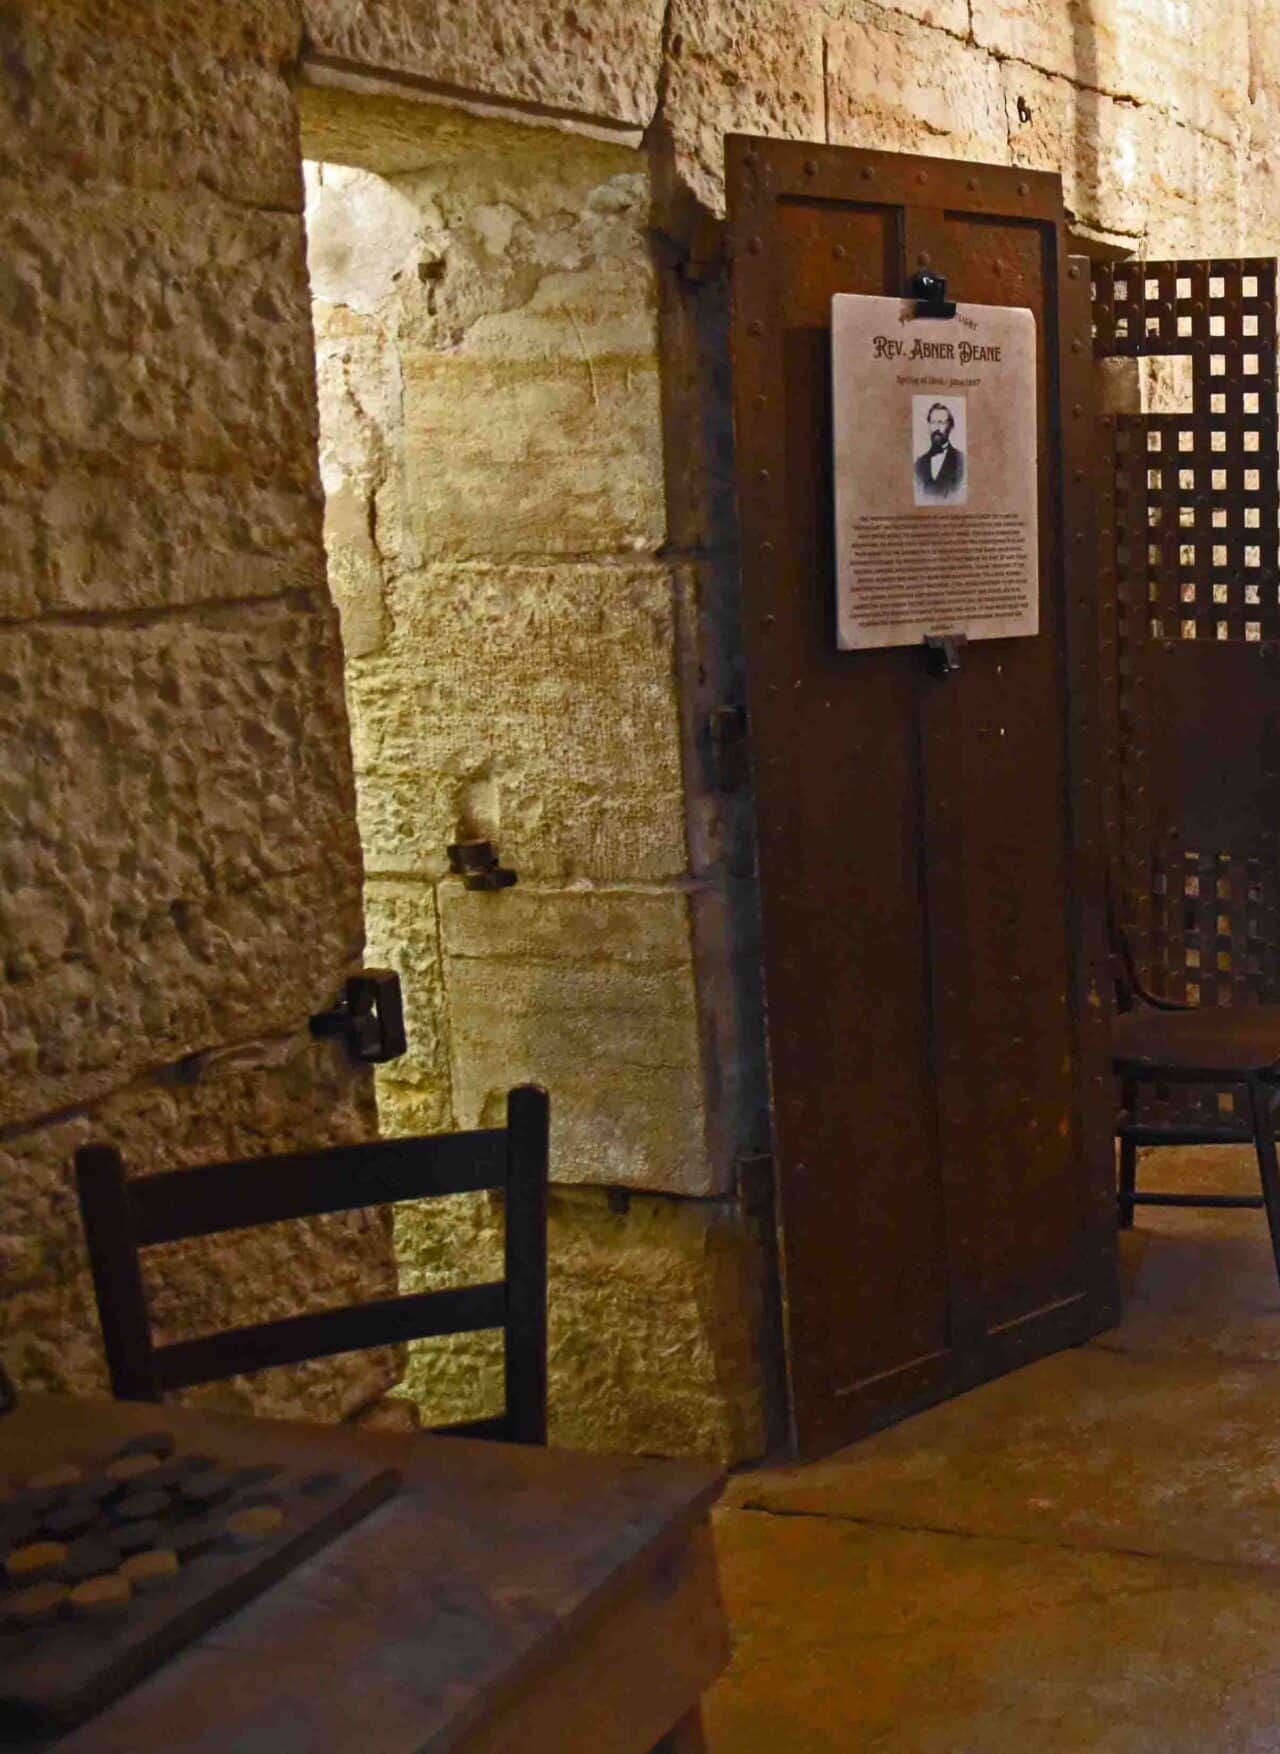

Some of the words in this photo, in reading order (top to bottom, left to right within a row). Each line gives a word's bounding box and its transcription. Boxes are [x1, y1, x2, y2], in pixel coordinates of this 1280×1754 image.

[873, 336, 907, 360] REV.
[909, 339, 955, 360] ABNER
[958, 341, 1001, 365] DEANE
